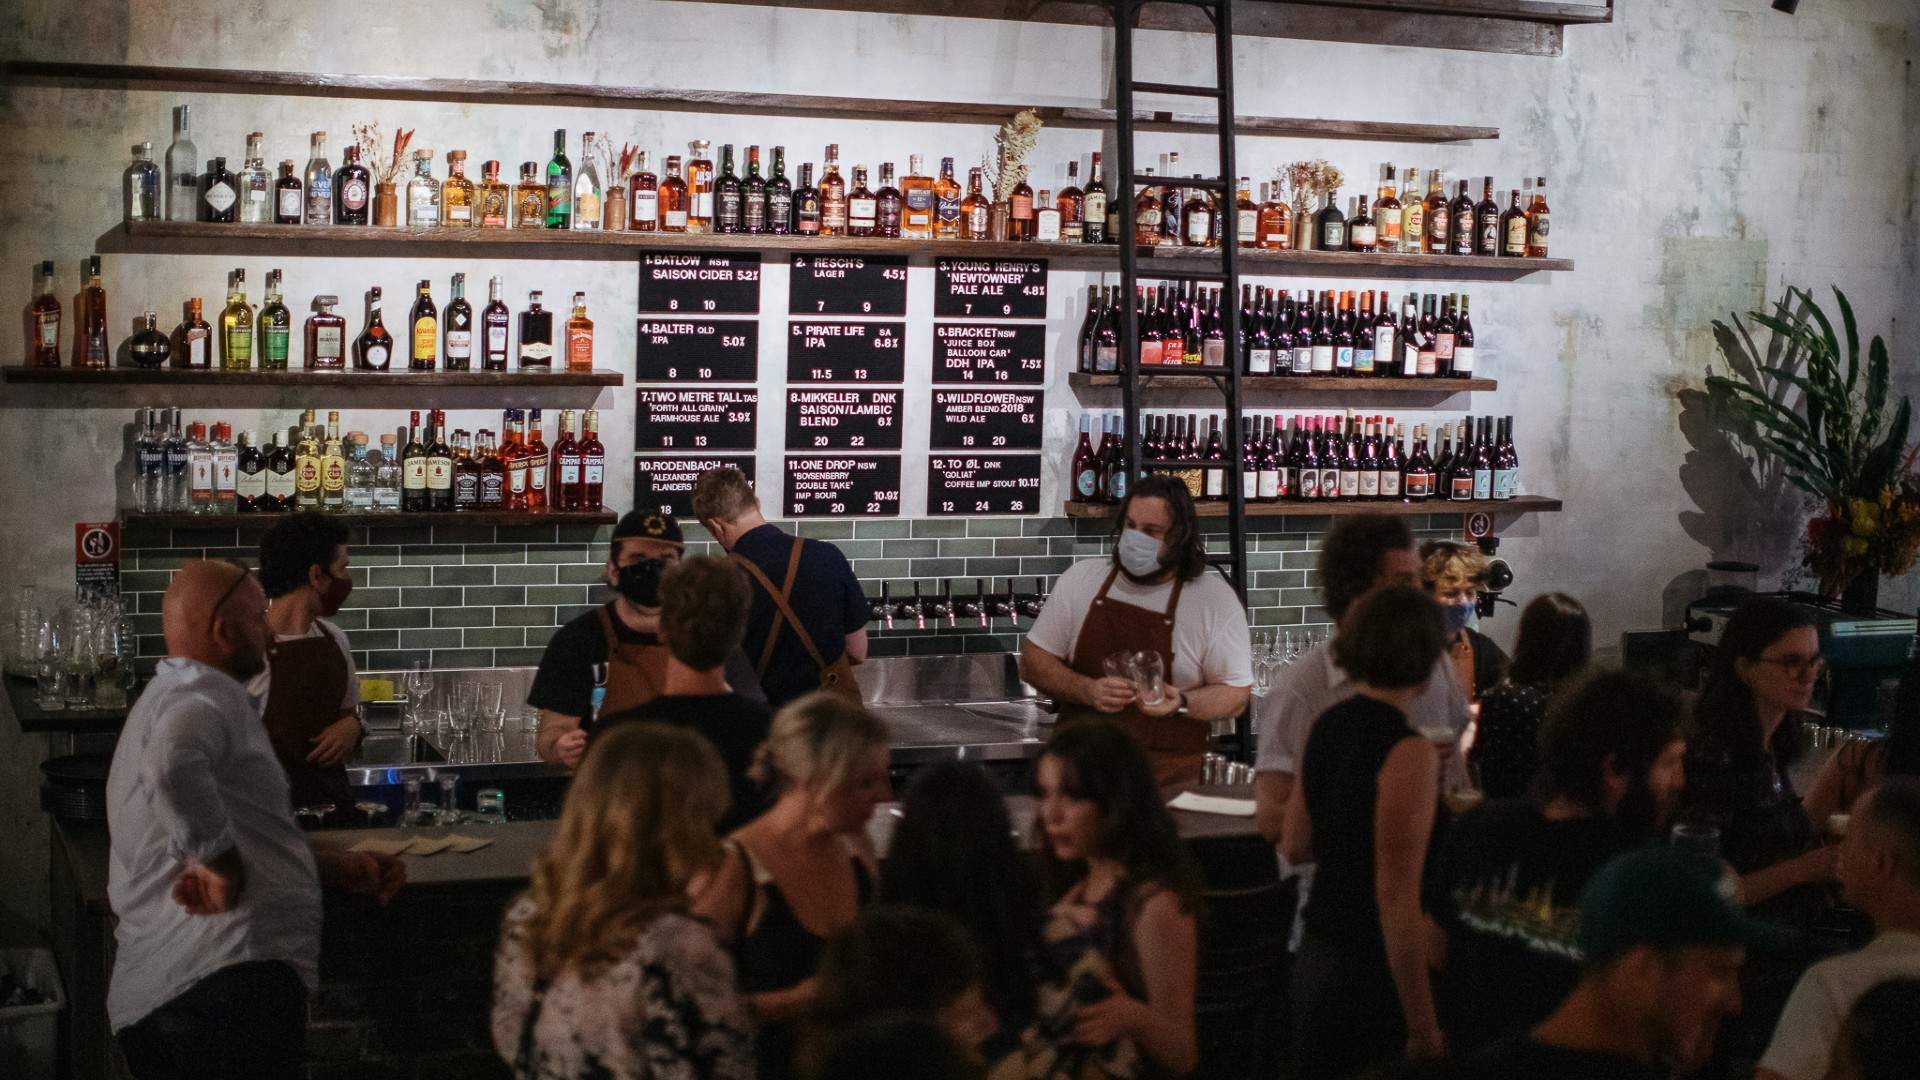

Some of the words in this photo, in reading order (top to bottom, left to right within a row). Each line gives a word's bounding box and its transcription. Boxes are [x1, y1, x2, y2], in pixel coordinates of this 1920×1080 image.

[654, 256, 700, 266] BATLOW
[814, 258, 864, 268] RESCH'S
[951, 262, 990, 272] YOUNG
[996, 262, 1040, 272] HENRY'S
[653, 270, 696, 280] SAISON
[699, 270, 732, 280] CIDER
[737, 270, 758, 280] 5.2%
[814, 270, 844, 278] LAGER
[883, 270, 906, 280] 4.5%
[948, 273, 1024, 284] 'NEWTOWNER'
[951, 285, 978, 294] PALE
[982, 286, 1004, 295] ALE
[1022, 286, 1045, 296] 4.8%
[670, 300, 678, 310] 8
[704, 300, 716, 310] 10
[818, 301, 824, 311] 7
[864, 302, 871, 312] 9
[966, 304, 972, 314] 7
[1003, 304, 1010, 314] 9
[652, 324, 694, 334] BALTER
[806, 326, 840, 336] PIRATE
[844, 326, 865, 336] LIFE
[880, 328, 892, 336] SA
[948, 328, 998, 338] BRACKET
[998, 330, 1016, 338] NSW
[652, 336, 668, 344] XPA
[723, 336, 746, 346] 5.0%
[806, 338, 826, 348] IPA
[874, 338, 898, 348] 6.8%
[946, 358, 970, 368] DDH
[977, 359, 995, 368] IPA
[1021, 359, 1042, 369] 7.5%
[669, 368, 676, 378] 8
[699, 368, 712, 378] 10
[812, 369, 832, 379] 11.5
[854, 370, 867, 379] 13
[963, 370, 974, 380] 14
[995, 371, 1008, 380] 16
[650, 392, 676, 402] TWO
[679, 392, 714, 402] METRE
[717, 392, 742, 402] TALL
[744, 394, 758, 402] TAS
[801, 393, 860, 402] MIKKELLER
[872, 394, 896, 403] DNK
[947, 394, 1016, 404] WILDFLOWER
[1016, 396, 1034, 404] NSW
[682, 404, 698, 412] ALL
[800, 405, 892, 414] SAISON/LAMBIC
[1000, 404, 1024, 412] 2018
[650, 414, 700, 422] FARMHOUSE
[704, 414, 720, 422] ALE
[728, 412, 750, 422] 3.9%
[800, 417, 838, 426] BLEND
[878, 417, 892, 426] 6%
[1022, 414, 1034, 423] 6%
[664, 436, 672, 446] 11
[696, 436, 707, 446] 13
[814, 436, 828, 446] 20
[850, 436, 864, 446] 22
[963, 436, 974, 446] 18
[992, 436, 1006, 446] 20
[654, 461, 720, 470] RODENBACH
[801, 460, 823, 470] ONE
[826, 460, 856, 470] DROP
[858, 462, 877, 470] NSW
[948, 460, 962, 469] TO
[966, 460, 980, 469] ØL
[652, 483, 692, 491] FLANDERS
[796, 482, 828, 490] DOUBLE
[944, 480, 974, 488] COFFEE
[976, 480, 990, 488] IMP
[993, 480, 1016, 488] STOUT
[1018, 478, 1039, 488] 10.1%
[796, 492, 811, 500] IMP
[814, 492, 837, 500] SOUR
[874, 491, 898, 500] 10.9%
[660, 505, 672, 514] 18
[794, 504, 804, 513] 10
[832, 503, 844, 512] 20
[867, 503, 880, 512] 22
[942, 502, 954, 512] 12
[976, 502, 989, 511] 24
[1010, 501, 1023, 511] 26
